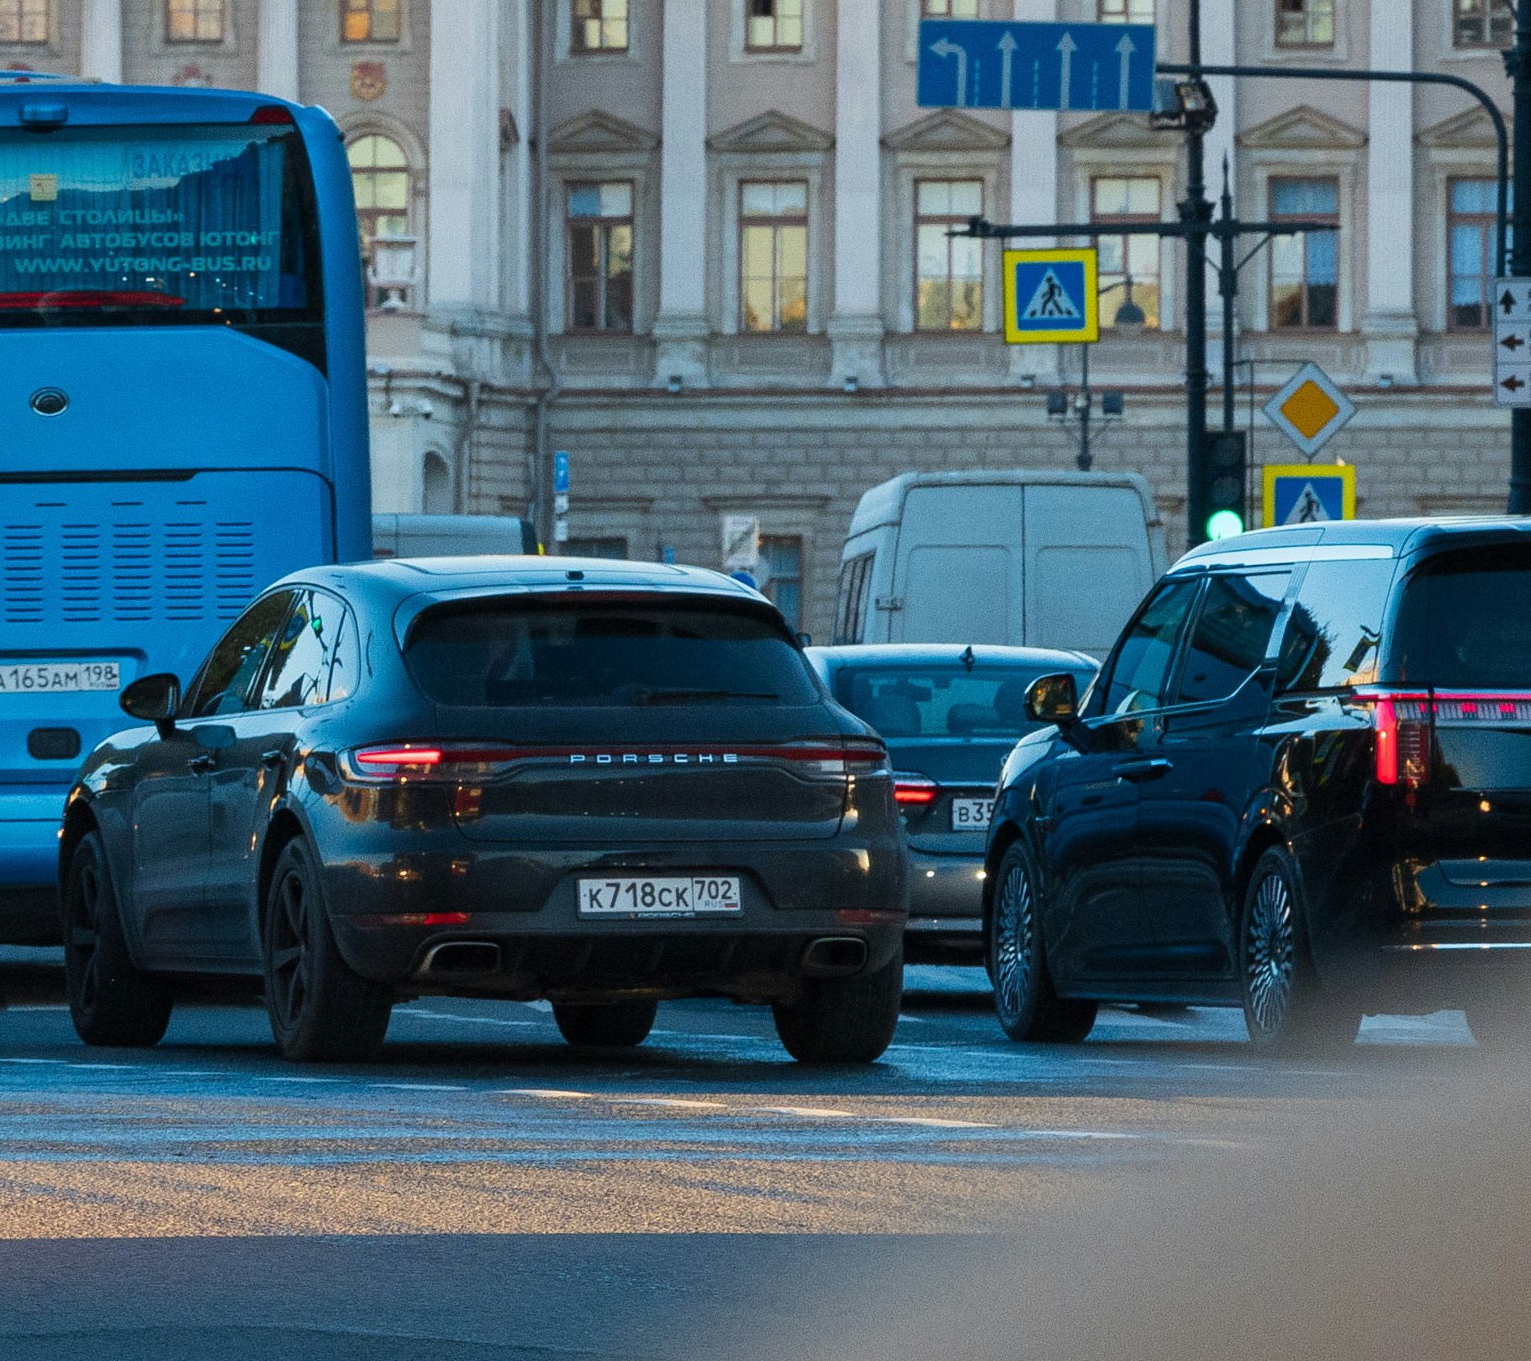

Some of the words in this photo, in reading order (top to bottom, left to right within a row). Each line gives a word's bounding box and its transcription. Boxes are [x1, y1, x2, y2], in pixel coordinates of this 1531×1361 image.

[60, 231, 195, 249] АВТОБУСОВ
[199, 230, 281, 247] ЮТОНГ
[14, 256, 272, 274] WWW.YUTONG-BUS.RU
[83, 665, 114, 681] 198
[570, 753, 738, 764] PORSCHE
[694, 879, 733, 900] 702
[704, 899, 724, 908] RUS
